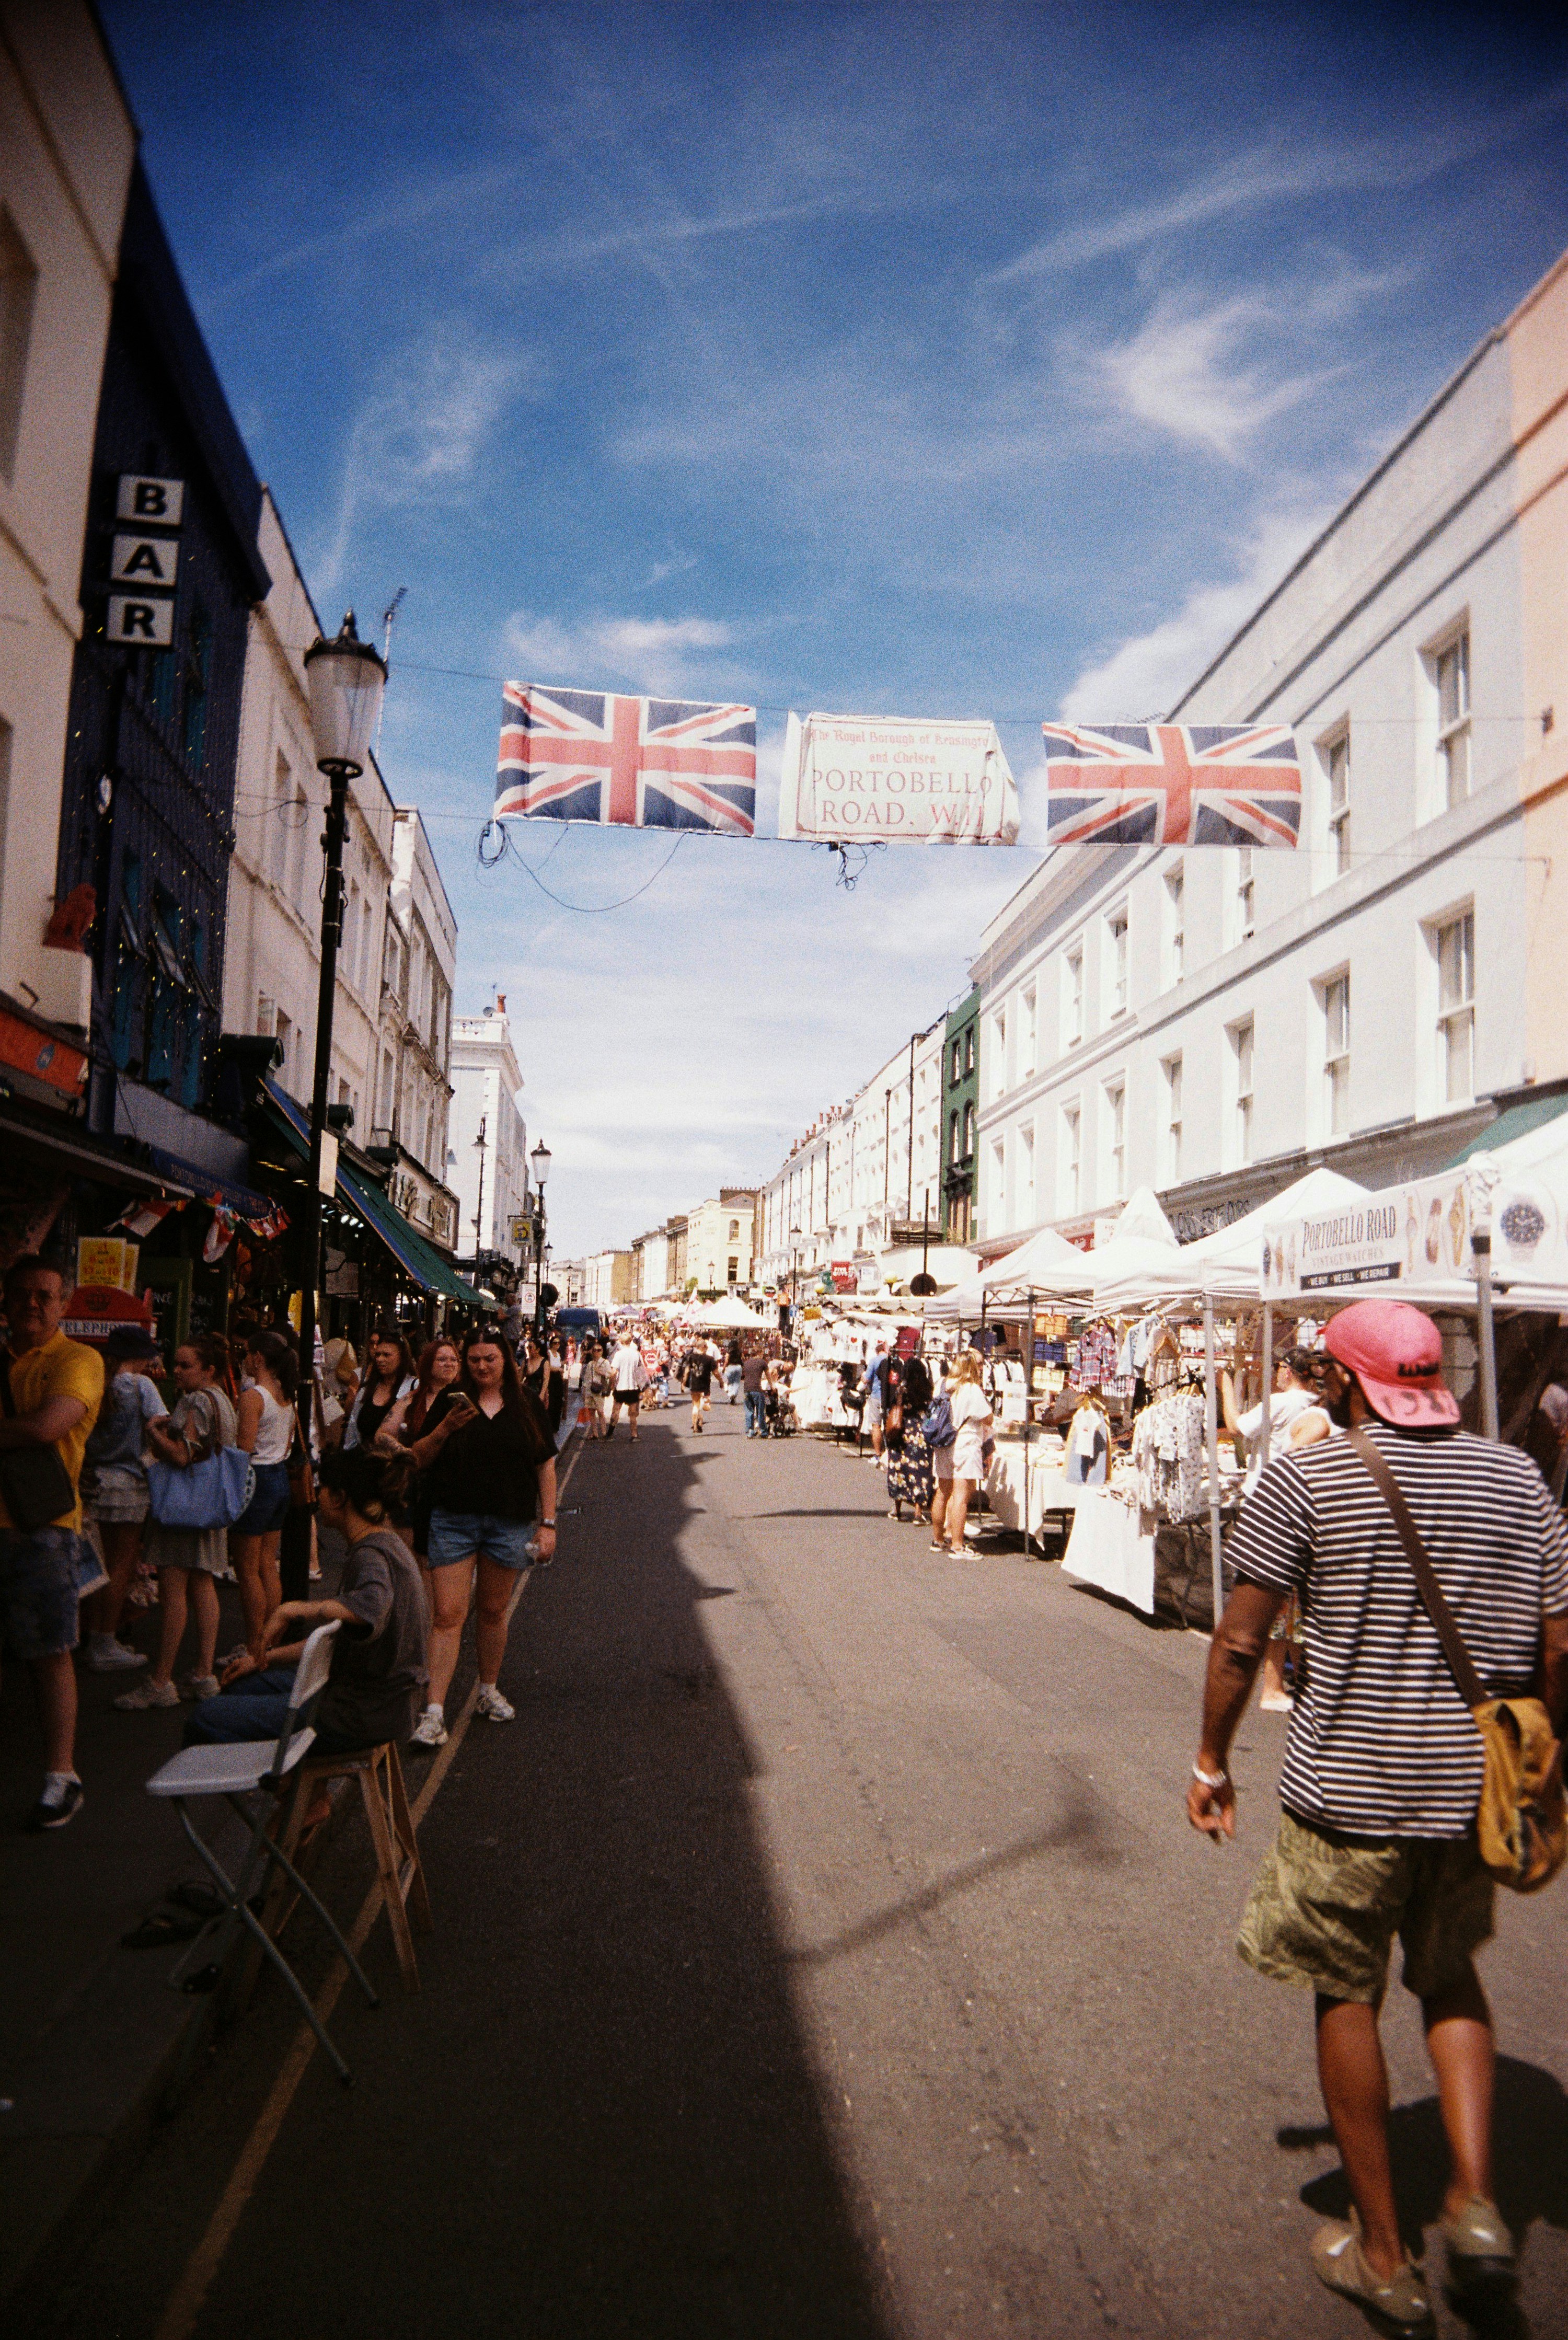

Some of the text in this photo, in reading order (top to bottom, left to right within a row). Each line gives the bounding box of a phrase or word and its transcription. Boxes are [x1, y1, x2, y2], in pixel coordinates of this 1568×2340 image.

[123, 483, 166, 637] BAR
[833, 730, 865, 745] Royal
[870, 732, 915, 747] Borough
[919, 733, 930, 744] of
[935, 733, 988, 750] Kensingto
[869, 751, 936, 764] and Chelsea
[812, 769, 992, 794] PORTOBELLO
[1302, 1205, 1397, 1258] PORTOBELLO ROAD
[1312, 1247, 1383, 1267] VINTAGE WATCHES
[1310, 1277, 1319, 1286] WE
[1333, 1273, 1342, 1283] WE
[1342, 1272, 1354, 1282] SELL
[1359, 1271, 1369, 1279] WE
[1369, 1267, 1389, 1278] REPAIR
